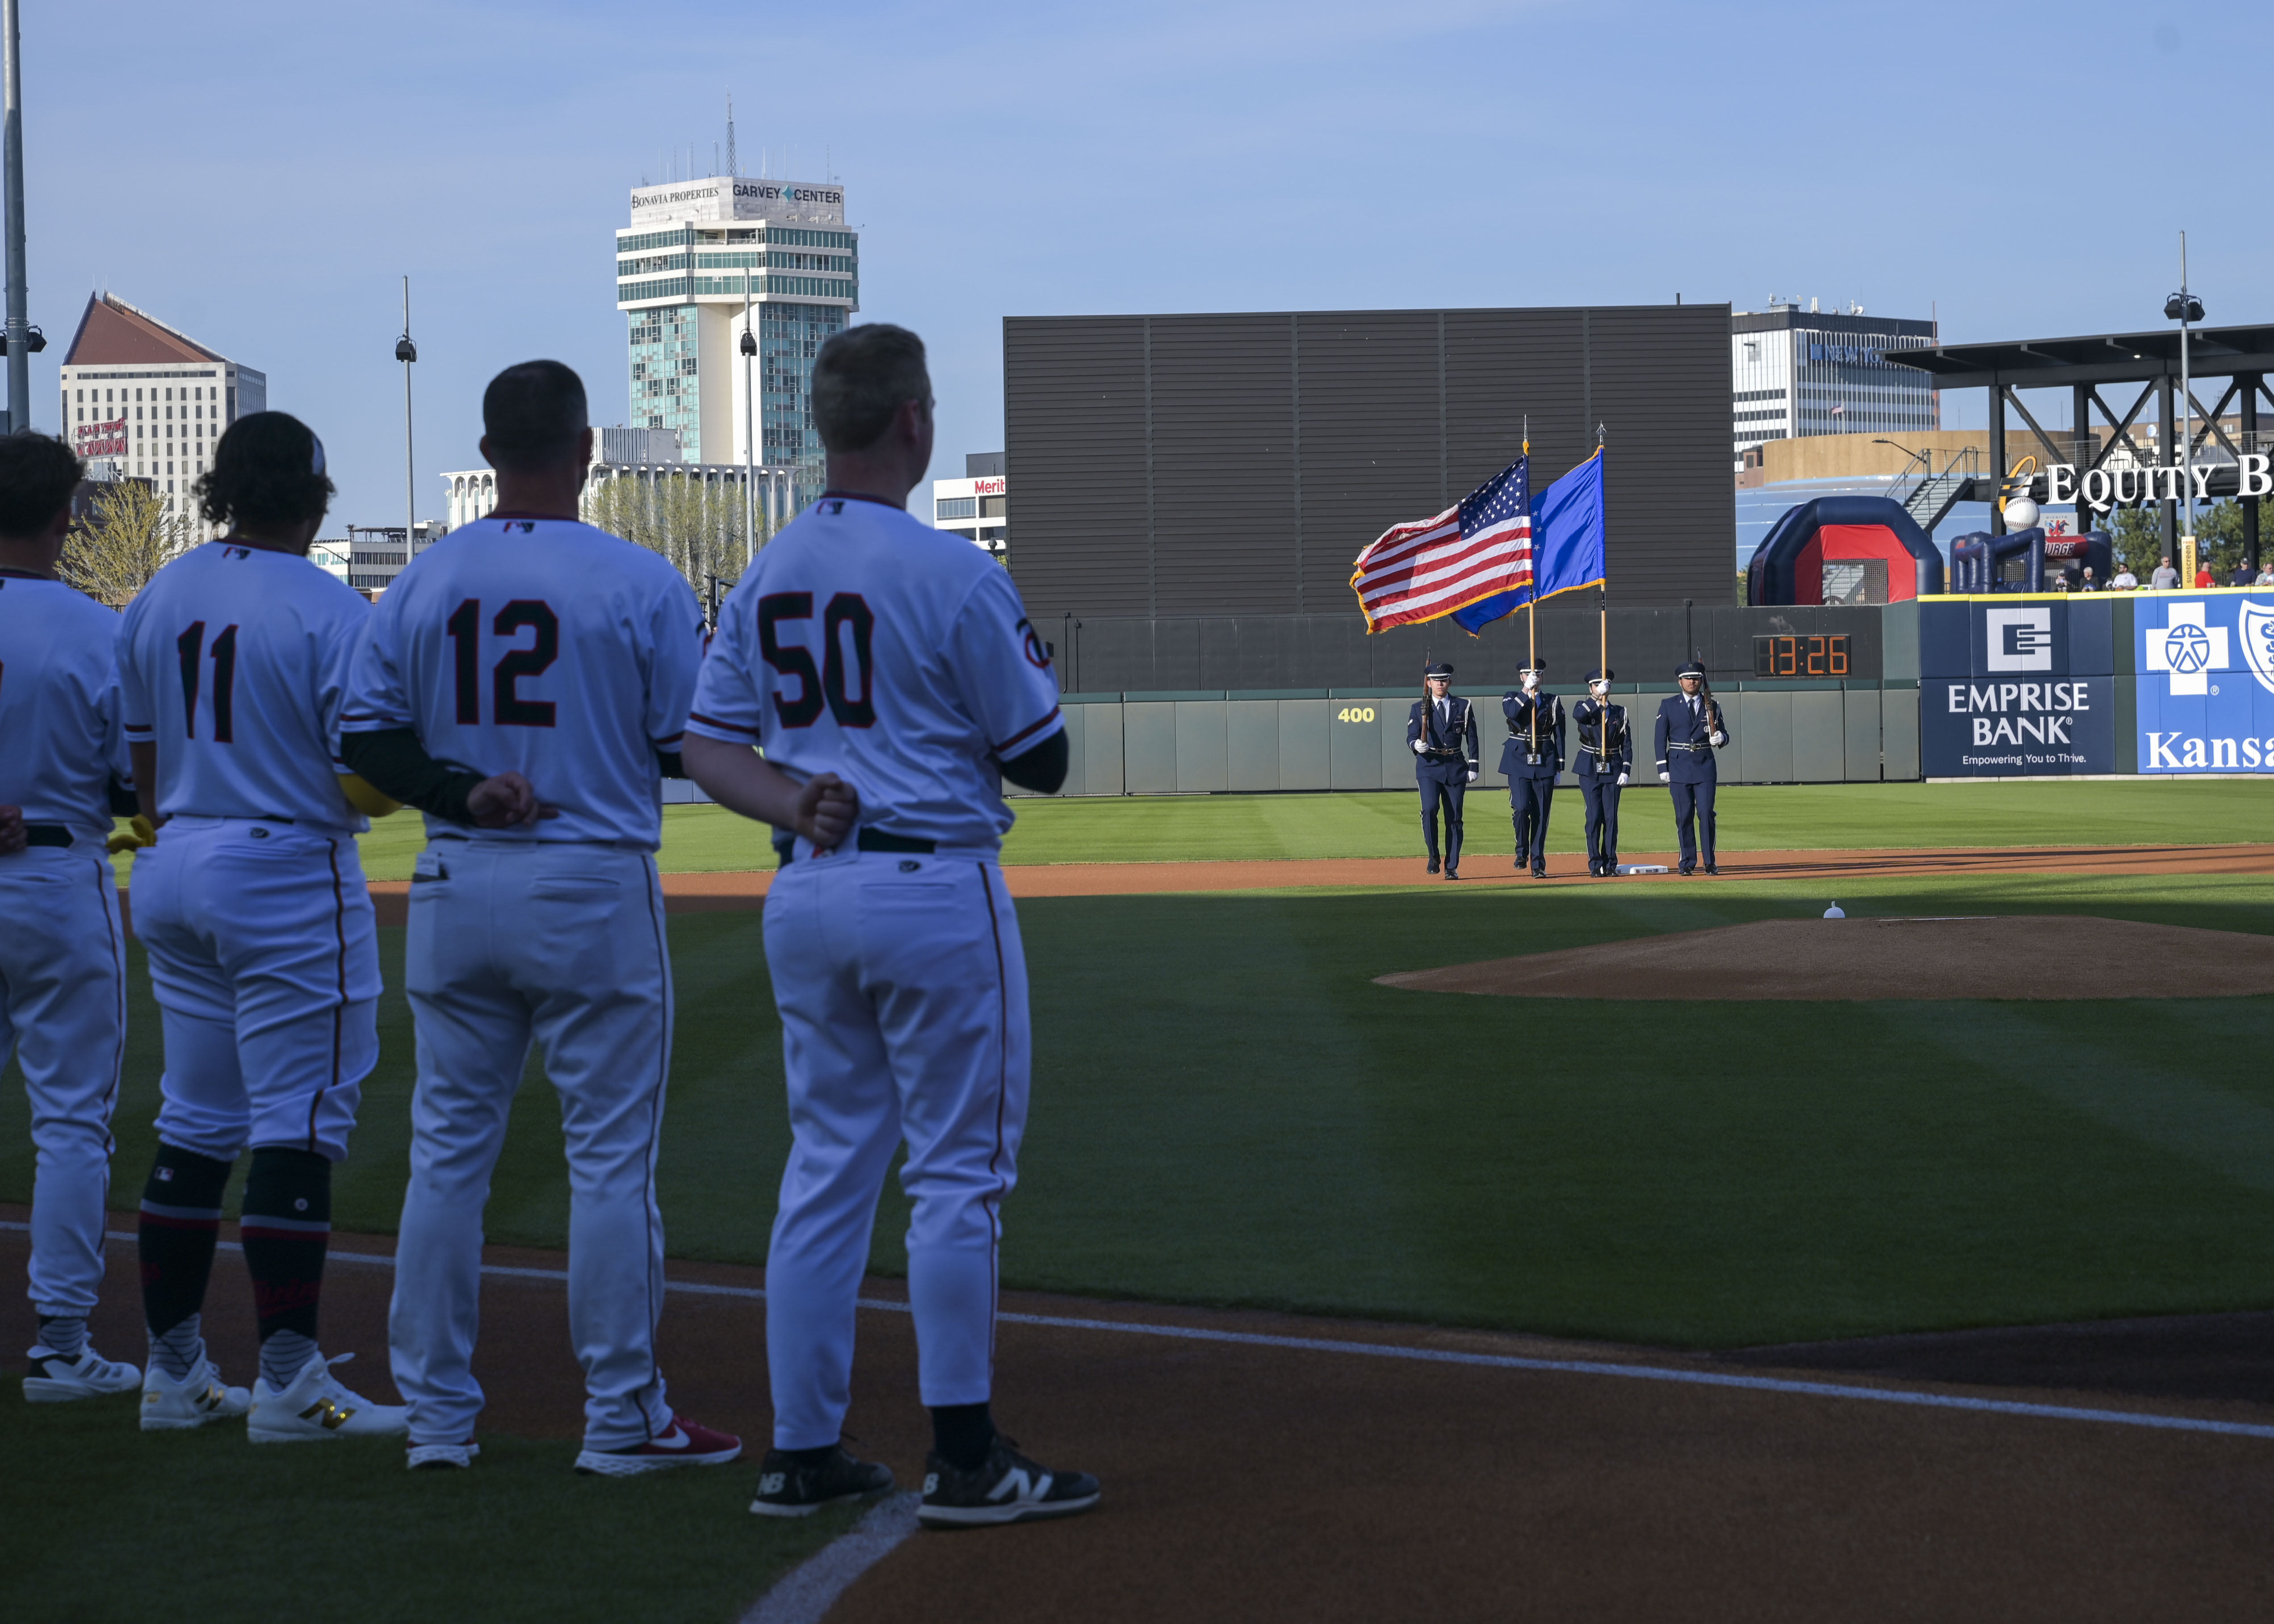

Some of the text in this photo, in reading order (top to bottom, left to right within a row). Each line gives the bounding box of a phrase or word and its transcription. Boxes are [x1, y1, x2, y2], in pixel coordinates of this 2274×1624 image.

[632, 187, 719, 209] BONAVIA PROPERTIES
[733, 184, 840, 203] GARVEY CENTER
[1825, 344, 1859, 363] NEW
[975, 479, 1005, 494] Merit
[2046, 464, 2217, 512] EQUITY
[448, 599, 559, 727] 12
[758, 591, 877, 729] 50
[1769, 636, 1847, 674] 13:26
[177, 620, 239, 743] 11
[1948, 682, 2089, 713] EMPRISE
[1338, 707, 1375, 723] 400
[1963, 754, 2022, 766] Empowering
[2026, 754, 2043, 763] You
[2046, 754, 2056, 763] to
